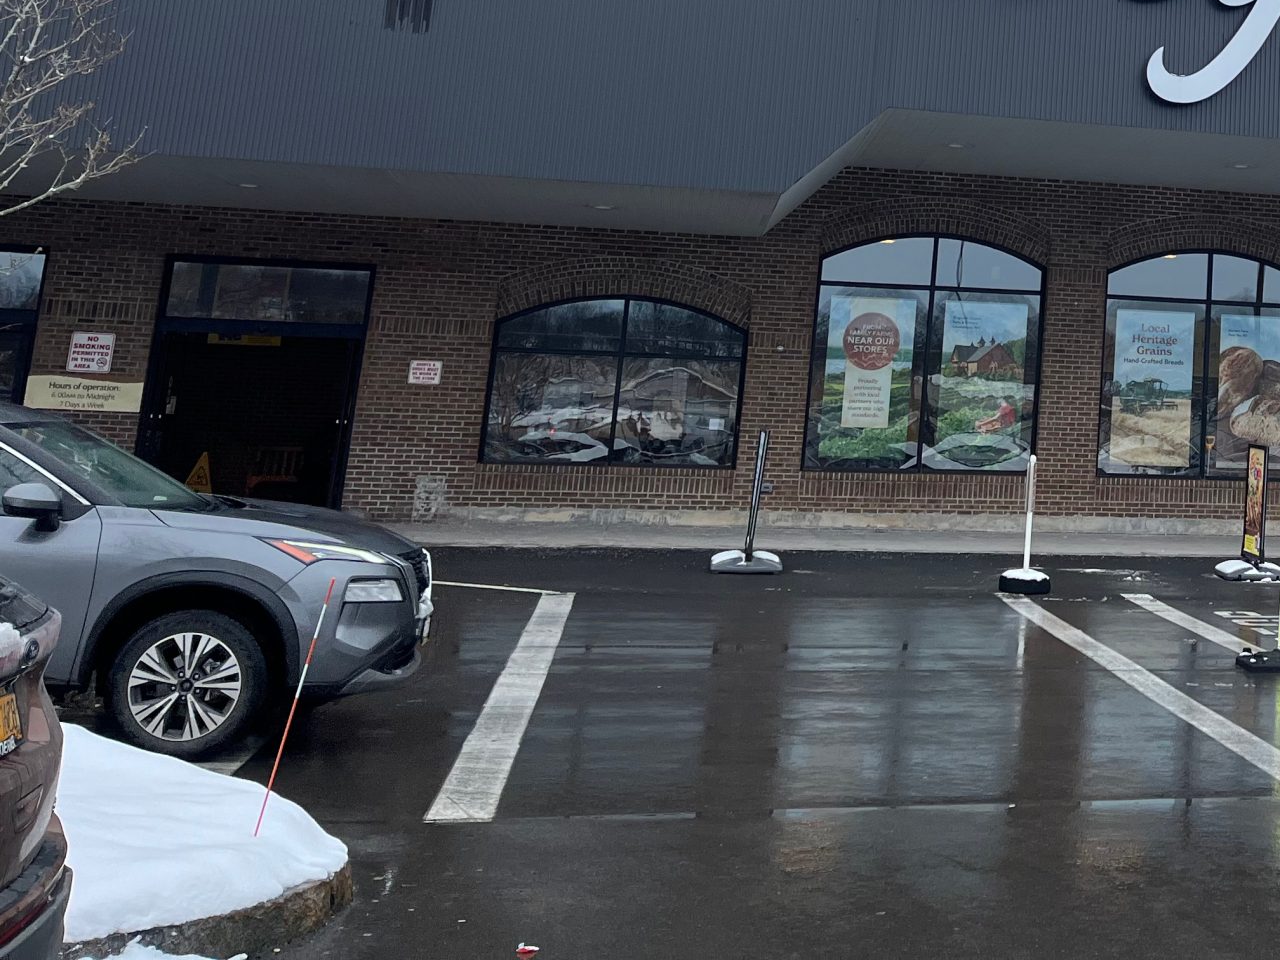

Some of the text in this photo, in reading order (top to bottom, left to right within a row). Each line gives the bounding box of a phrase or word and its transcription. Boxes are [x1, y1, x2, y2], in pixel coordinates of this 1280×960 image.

[1141, 323, 1170, 333] Local
[847, 336, 895, 345] NEAR OUR
[1132, 334, 1178, 346] Heritage
[852, 345, 888, 353] STORES
[1136, 345, 1172, 356] Grains
[48, 381, 121, 392] Hours of operation:
[86, 392, 115, 401] Midnight
[64, 401, 80, 409] Days
[87, 401, 105, 409] Week
